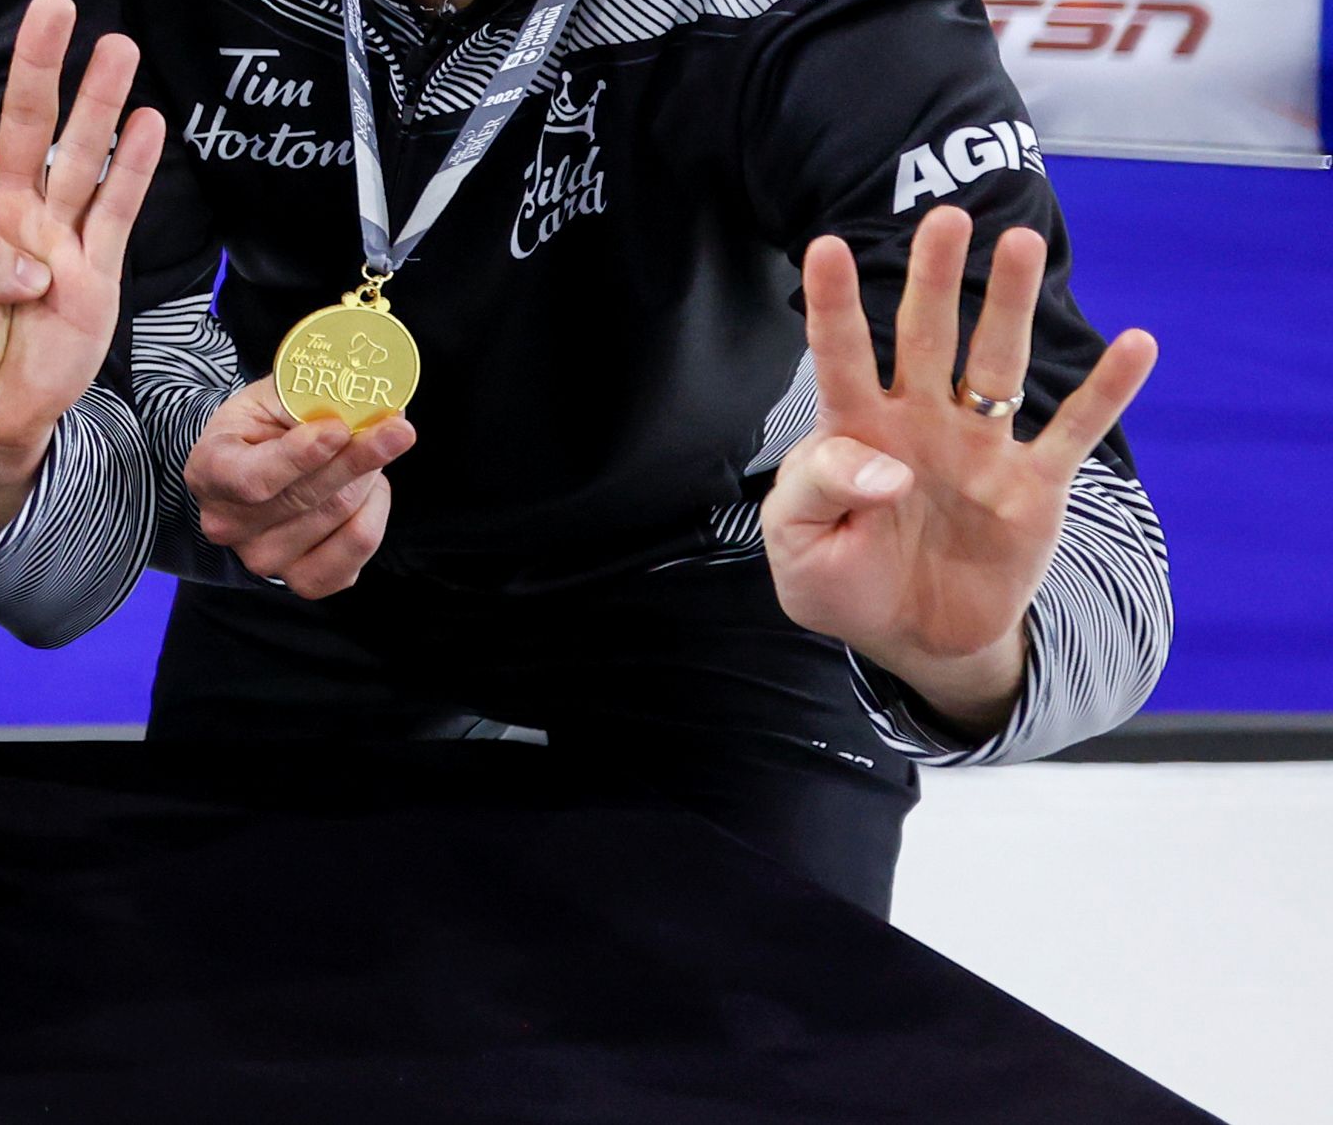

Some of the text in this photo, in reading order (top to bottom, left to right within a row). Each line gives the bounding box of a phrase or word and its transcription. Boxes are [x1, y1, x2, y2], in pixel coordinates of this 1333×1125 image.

[532, 2, 565, 46] CANADA
[219, 47, 314, 108] Tim
[482, 86, 524, 108] 2022
[183, 102, 356, 170] Horton
[892, 121, 1023, 216] AGI
[510, 172, 607, 259] Card
[307, 333, 333, 352] Tim
[290, 364, 395, 409] BRIER
